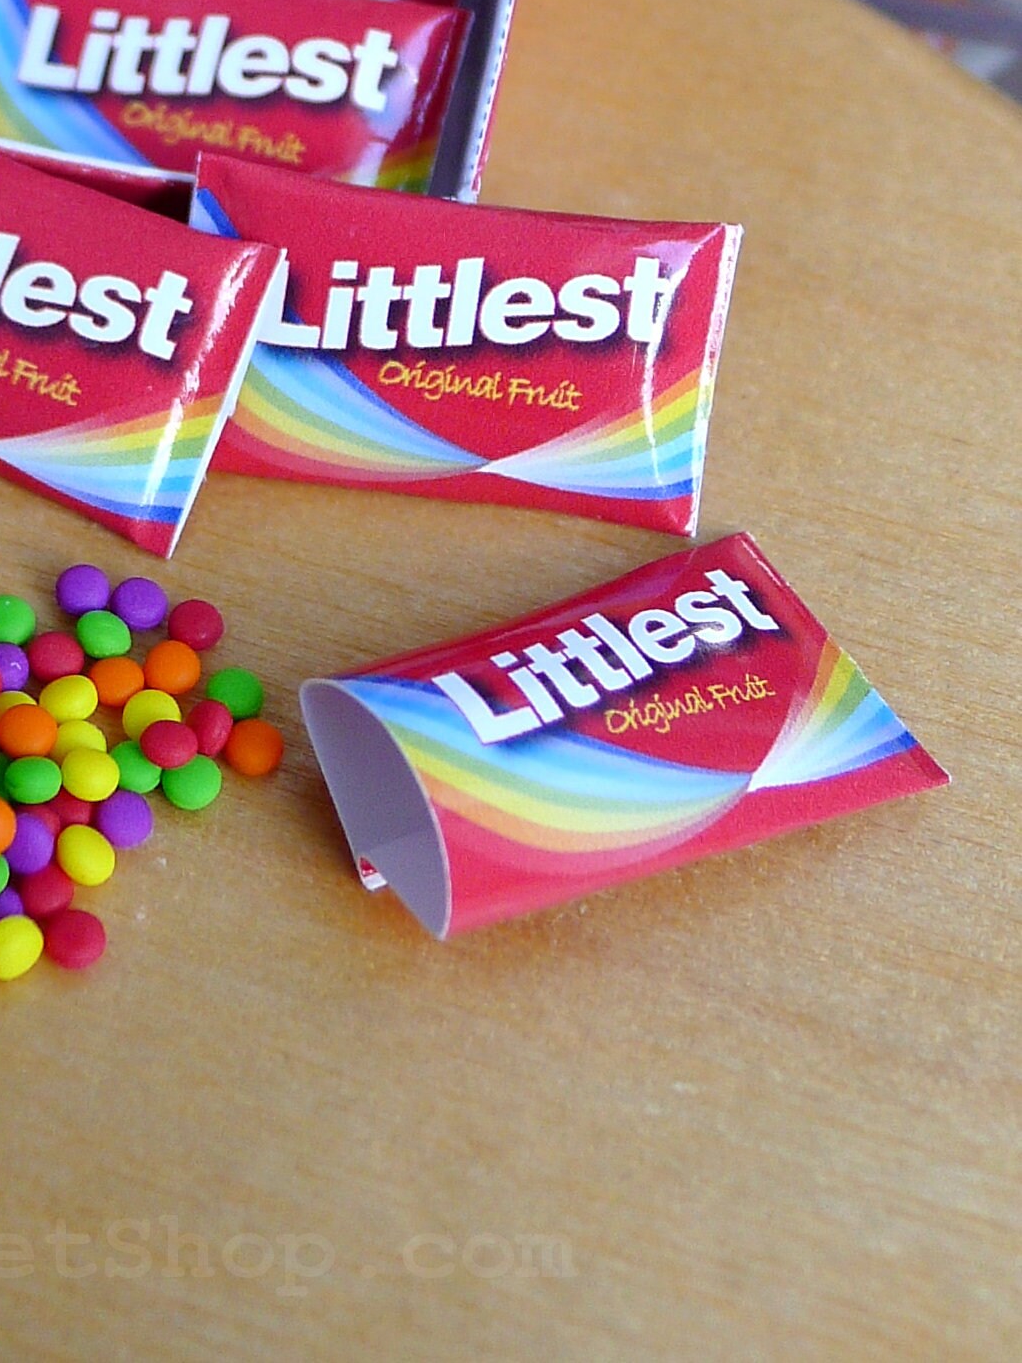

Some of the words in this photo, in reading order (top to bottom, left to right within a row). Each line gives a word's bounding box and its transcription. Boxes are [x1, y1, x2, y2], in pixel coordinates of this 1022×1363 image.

[18, 5, 399, 112] Littlest
[256, 255, 670, 350] Littlest
[11, 357, 83, 407] Fruit
[379, 360, 504, 402] Original
[507, 377, 583, 412] Fruit
[432, 568, 779, 744] Littlest
[604, 686, 714, 734] Original
[708, 673, 776, 710] Fruit
